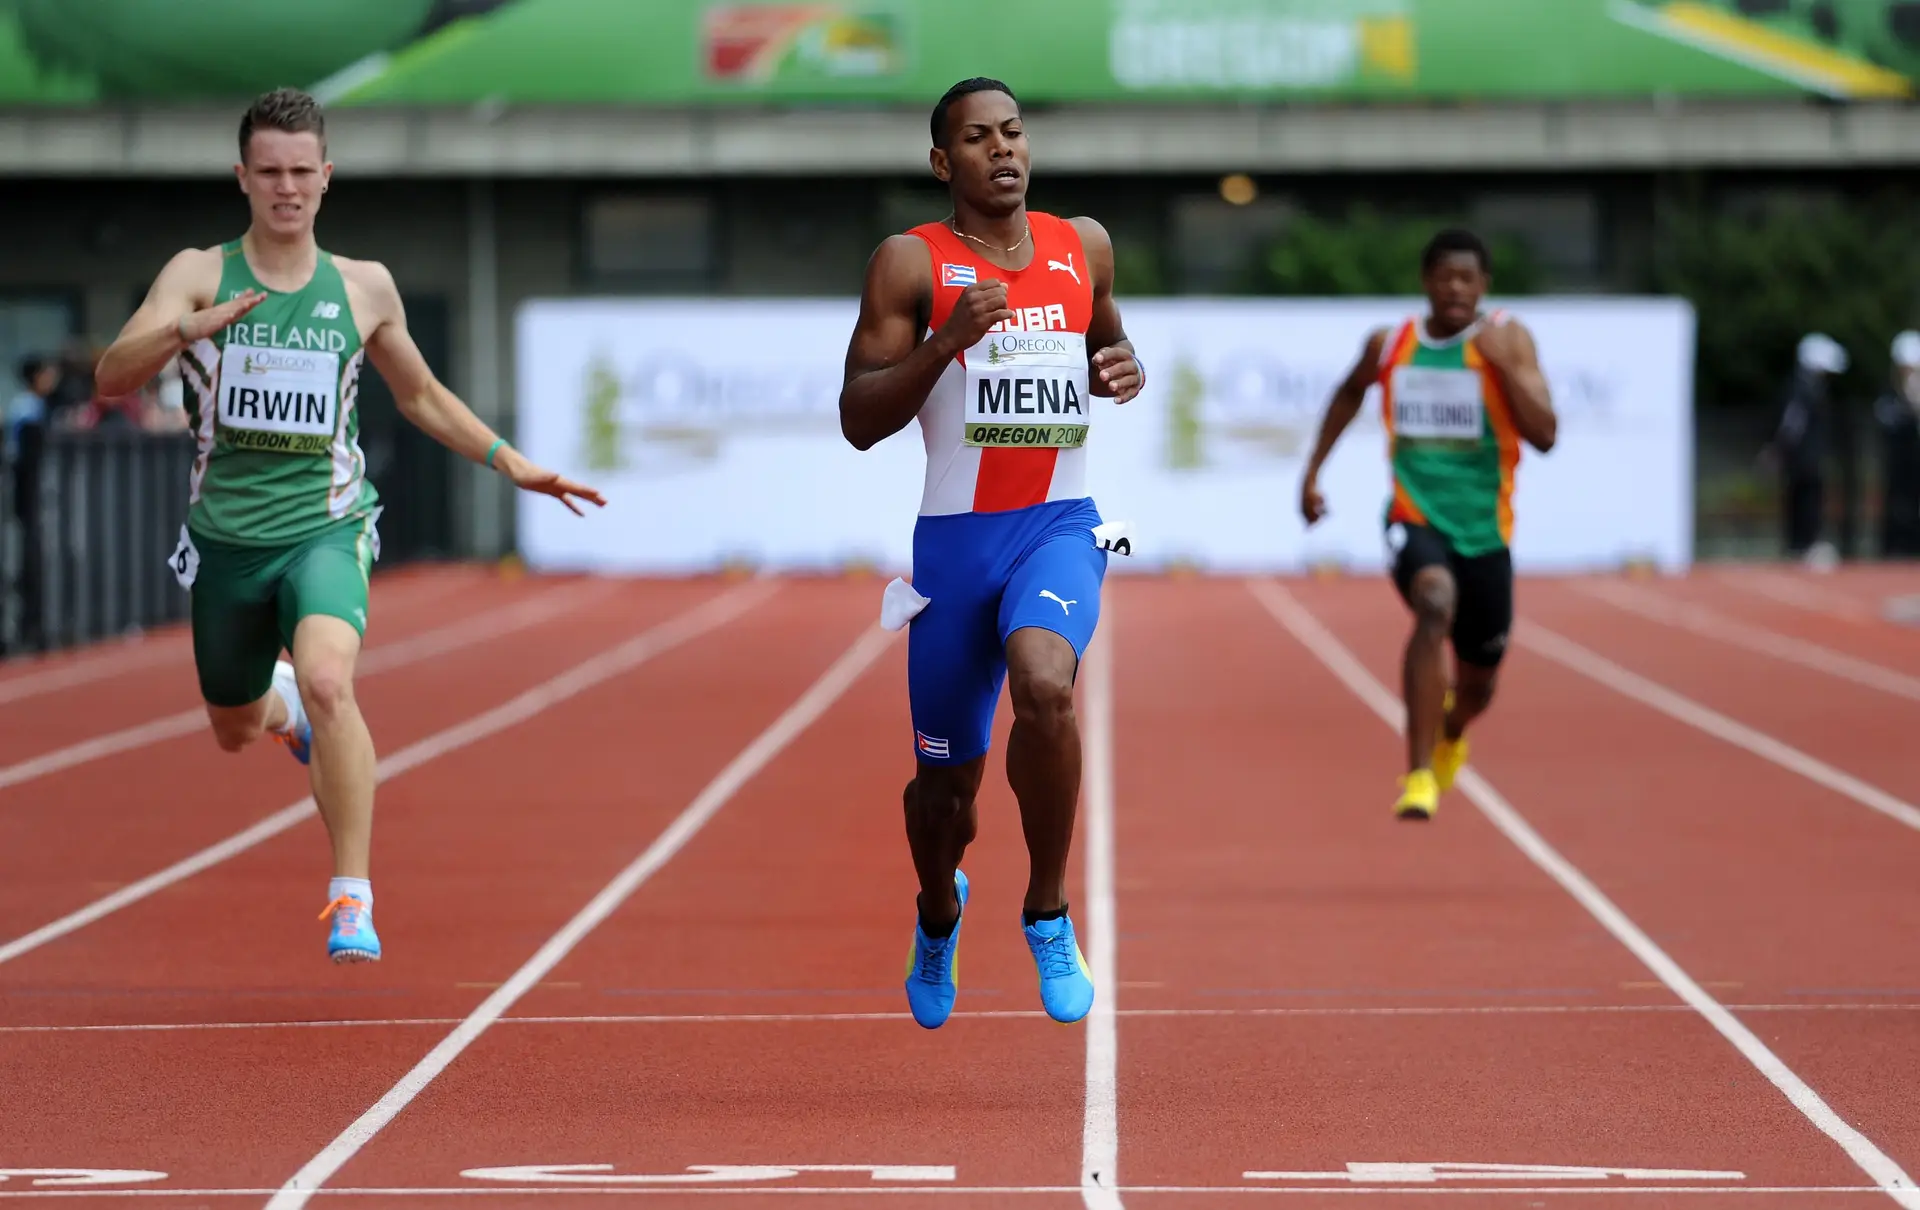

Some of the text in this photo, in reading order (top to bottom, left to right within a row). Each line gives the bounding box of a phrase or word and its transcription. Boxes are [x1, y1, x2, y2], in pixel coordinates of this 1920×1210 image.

[310, 300, 342, 320] NB
[225, 323, 347, 353] IRELAND
[1002, 335, 1066, 352] OREGON
[227, 386, 327, 424] IRWIN
[977, 378, 1083, 415] MENA
[225, 428, 292, 449] OREGON
[973, 426, 1085, 444] OREGON 2014
[177, 546, 190, 574] 6
